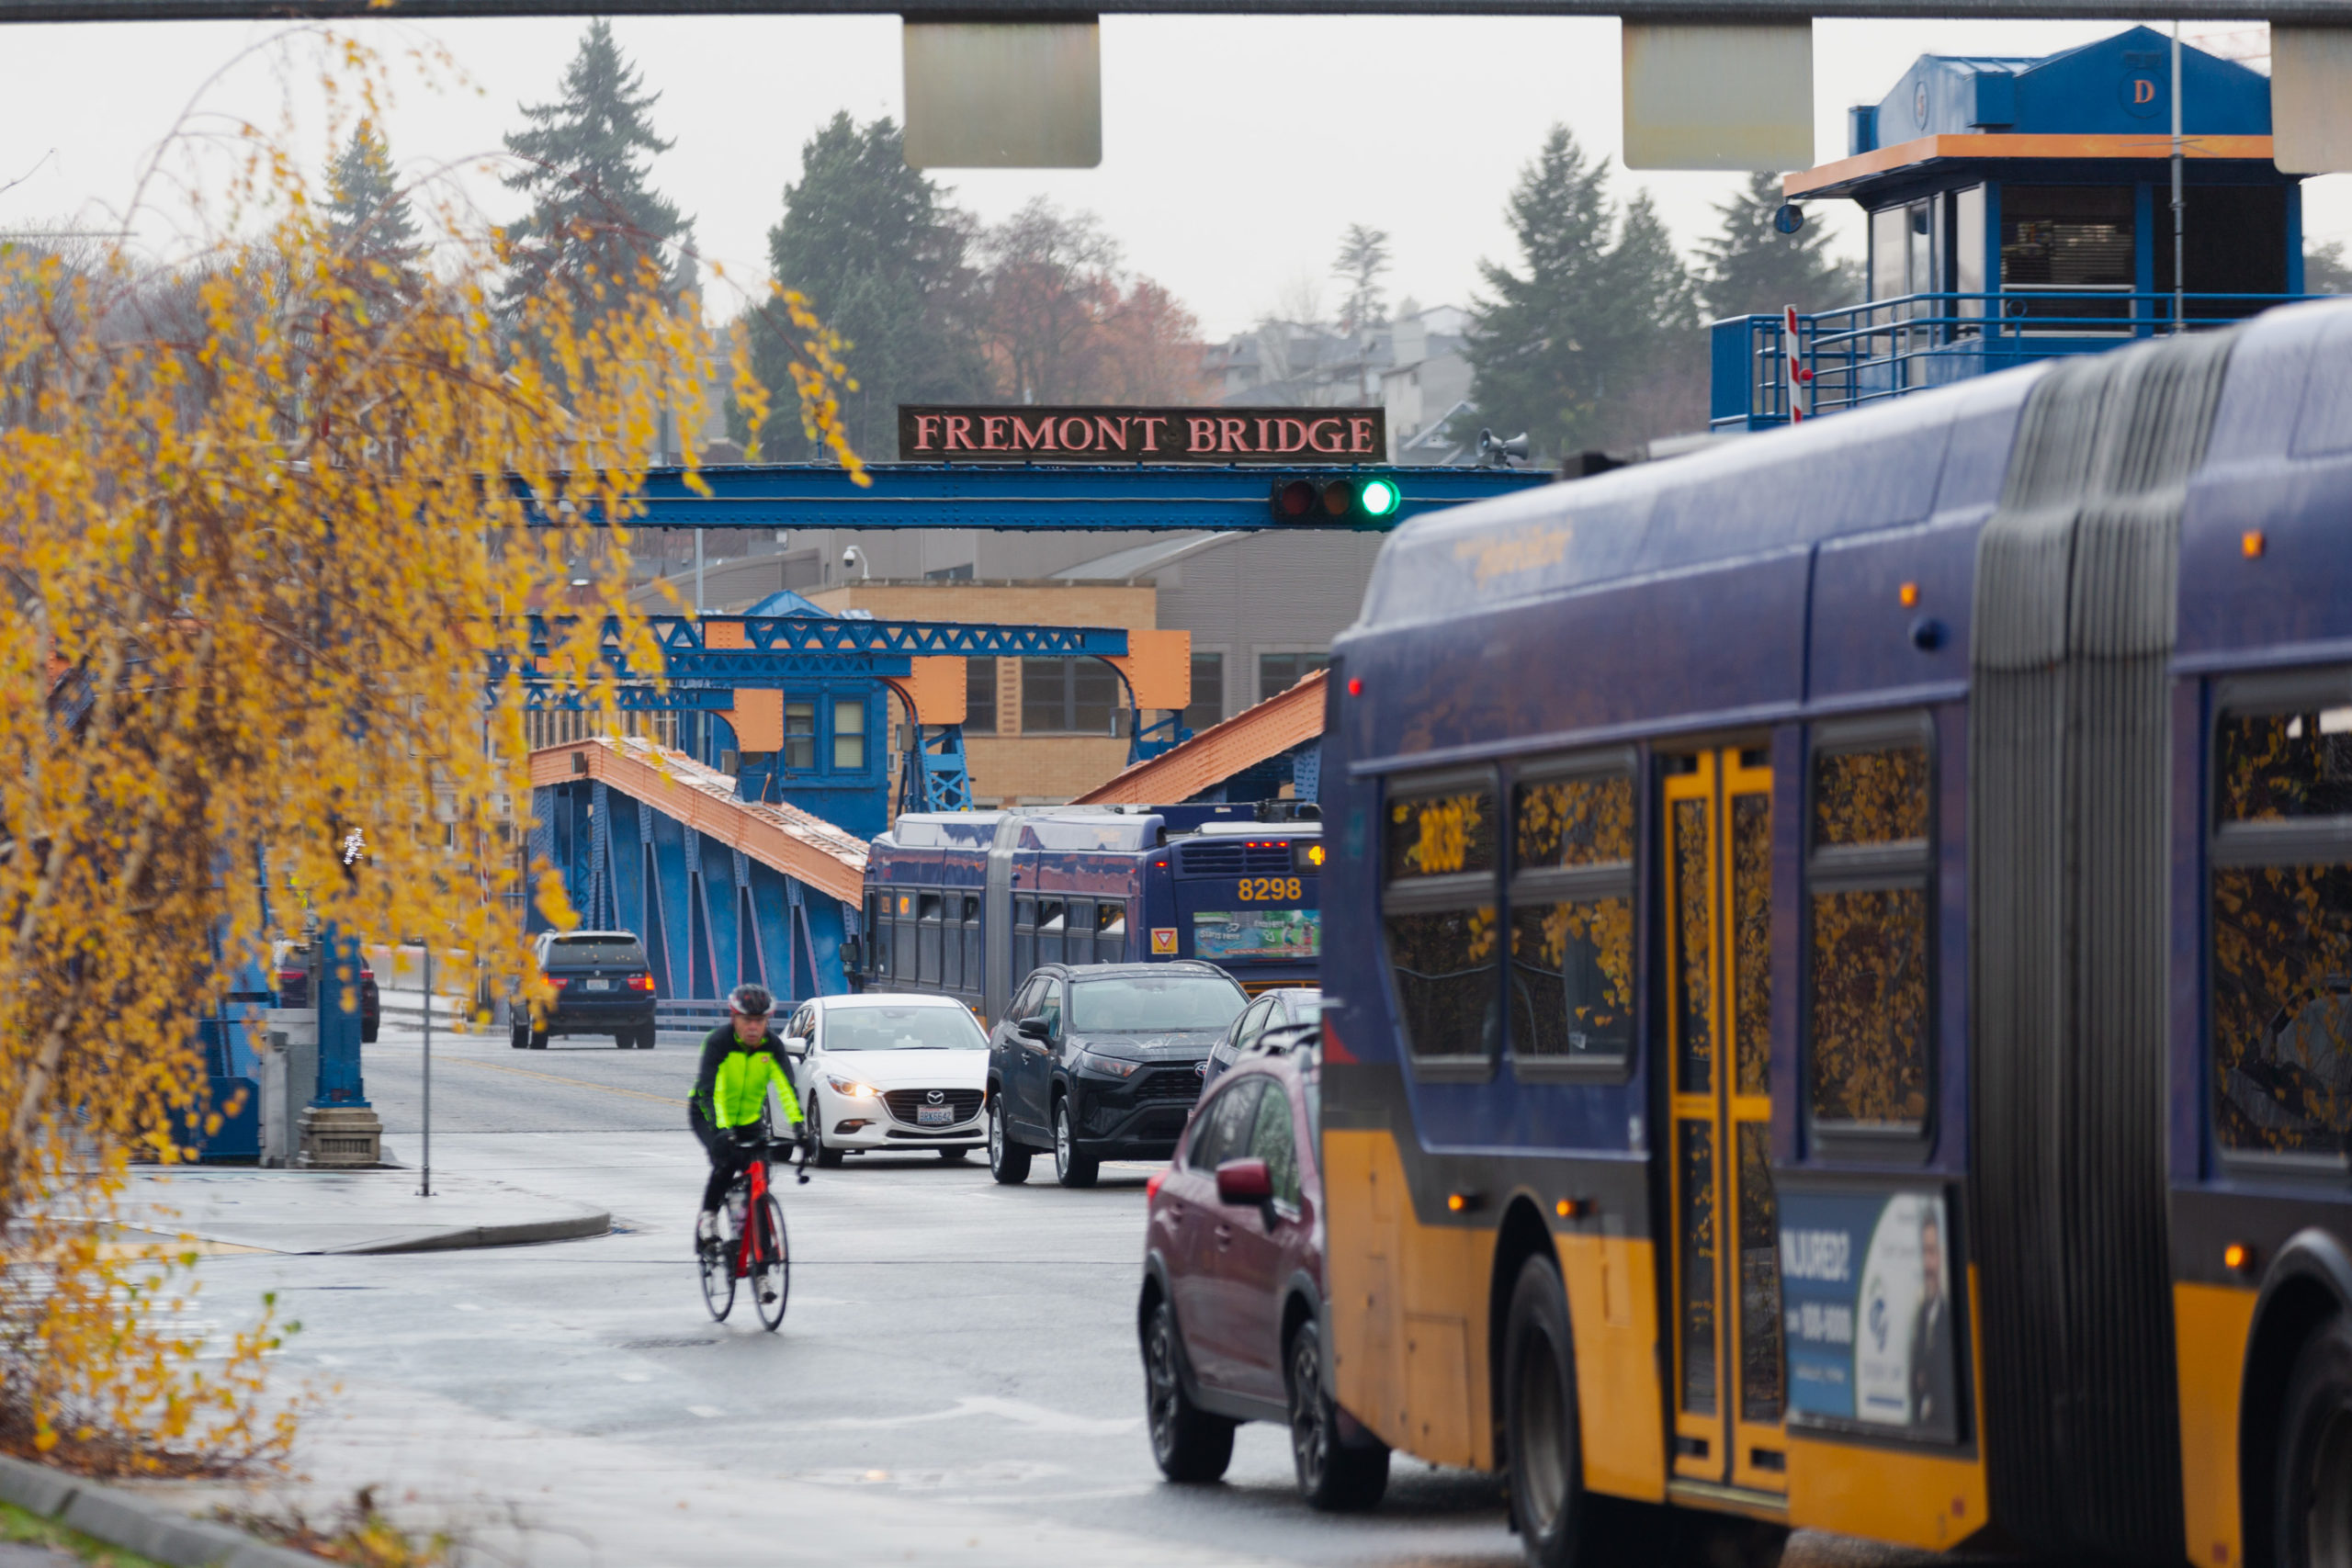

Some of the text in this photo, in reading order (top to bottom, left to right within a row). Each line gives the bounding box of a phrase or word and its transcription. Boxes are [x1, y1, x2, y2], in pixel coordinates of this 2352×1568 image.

[2133, 79, 2154, 103] D
[913, 414, 1375, 453] FREMONT BRIDGE
[1308, 845, 1326, 865] 4
[1238, 877, 1302, 901] 8298
